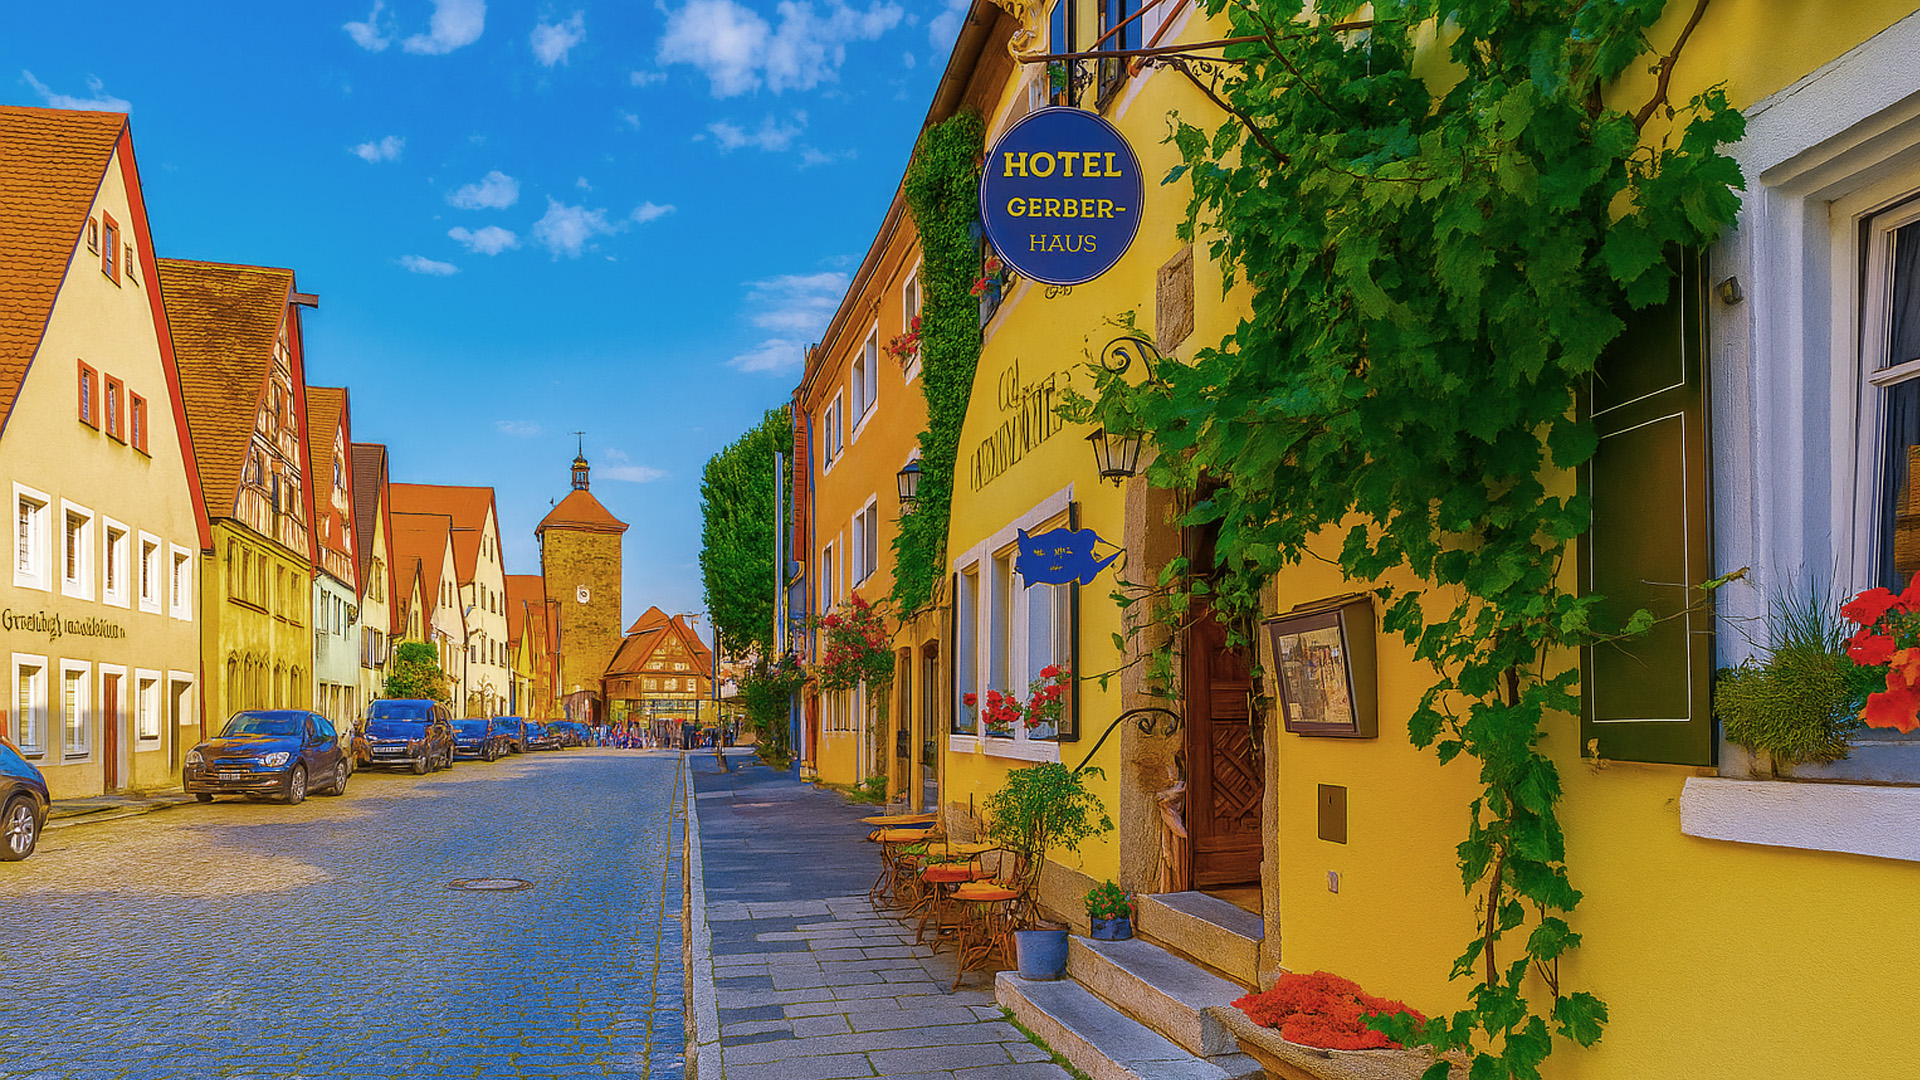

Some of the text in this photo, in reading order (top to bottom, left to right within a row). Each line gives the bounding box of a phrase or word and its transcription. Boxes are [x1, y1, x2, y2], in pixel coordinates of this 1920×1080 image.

[1003, 151, 1122, 178] HOTEL
[1007, 197, 1127, 219] GERBER-
[1029, 234, 1097, 253] HAUS
